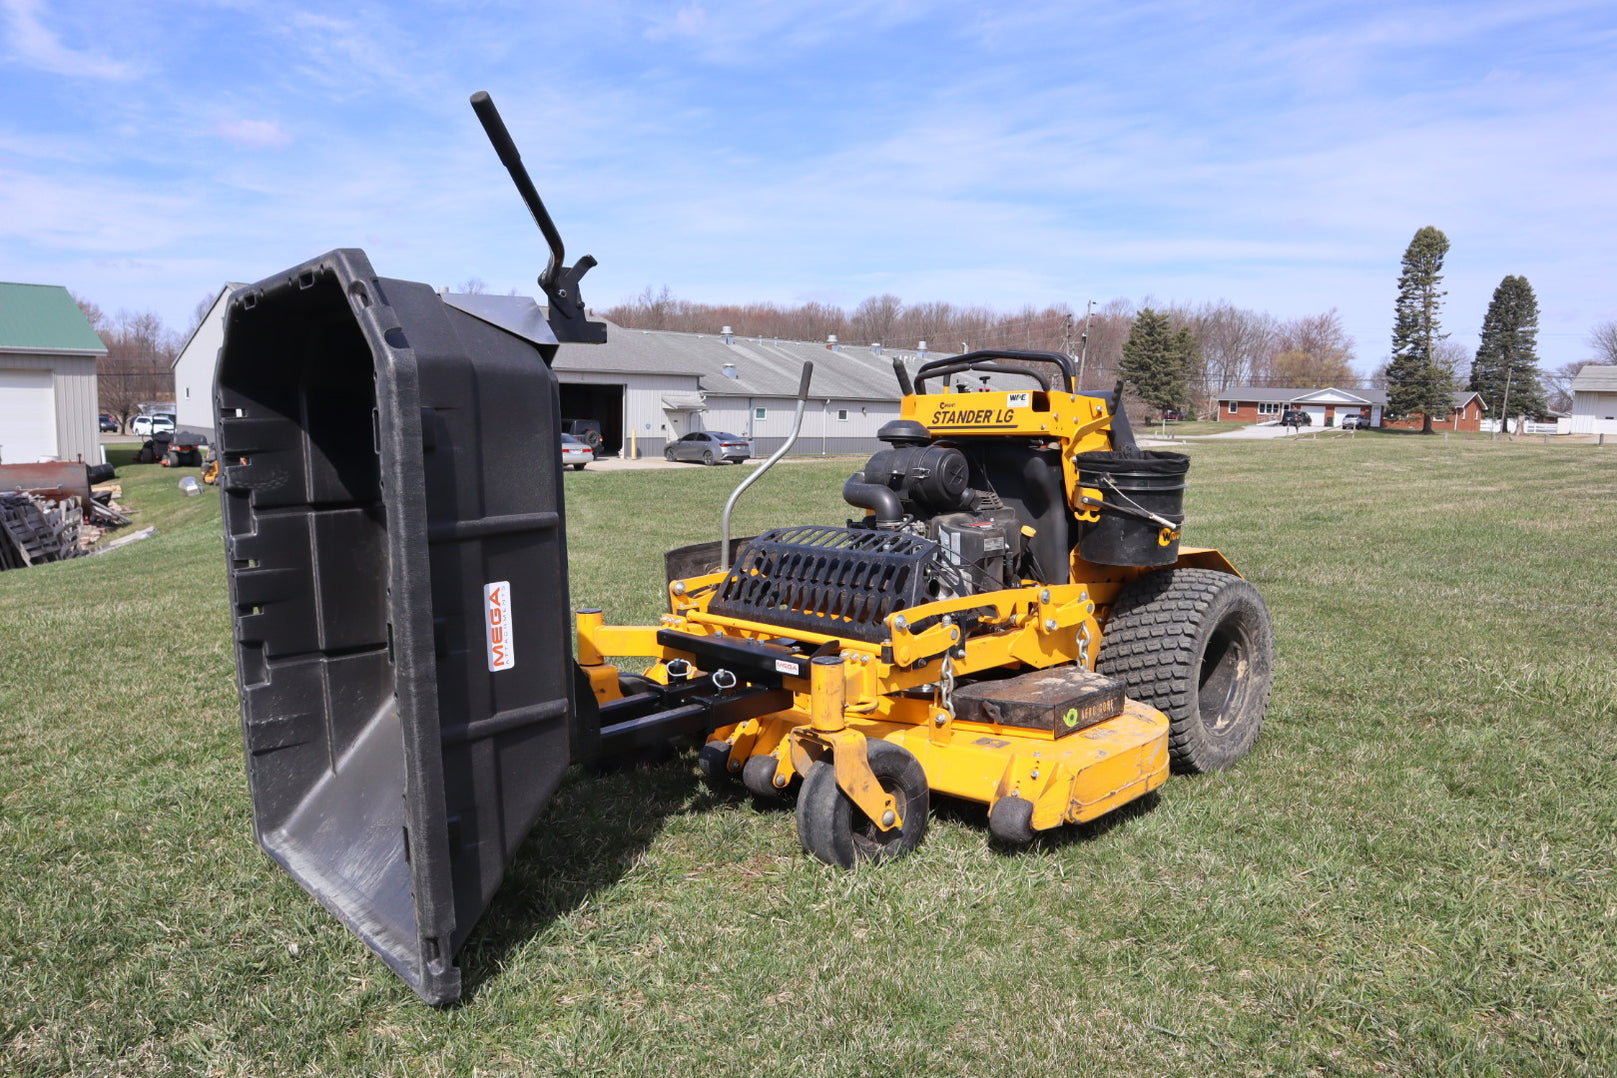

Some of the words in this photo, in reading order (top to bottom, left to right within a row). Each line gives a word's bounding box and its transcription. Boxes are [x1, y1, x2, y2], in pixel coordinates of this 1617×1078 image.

[932, 409, 993, 424] STANDER
[996, 408, 1014, 423] LG
[489, 587, 504, 666] MEGA
